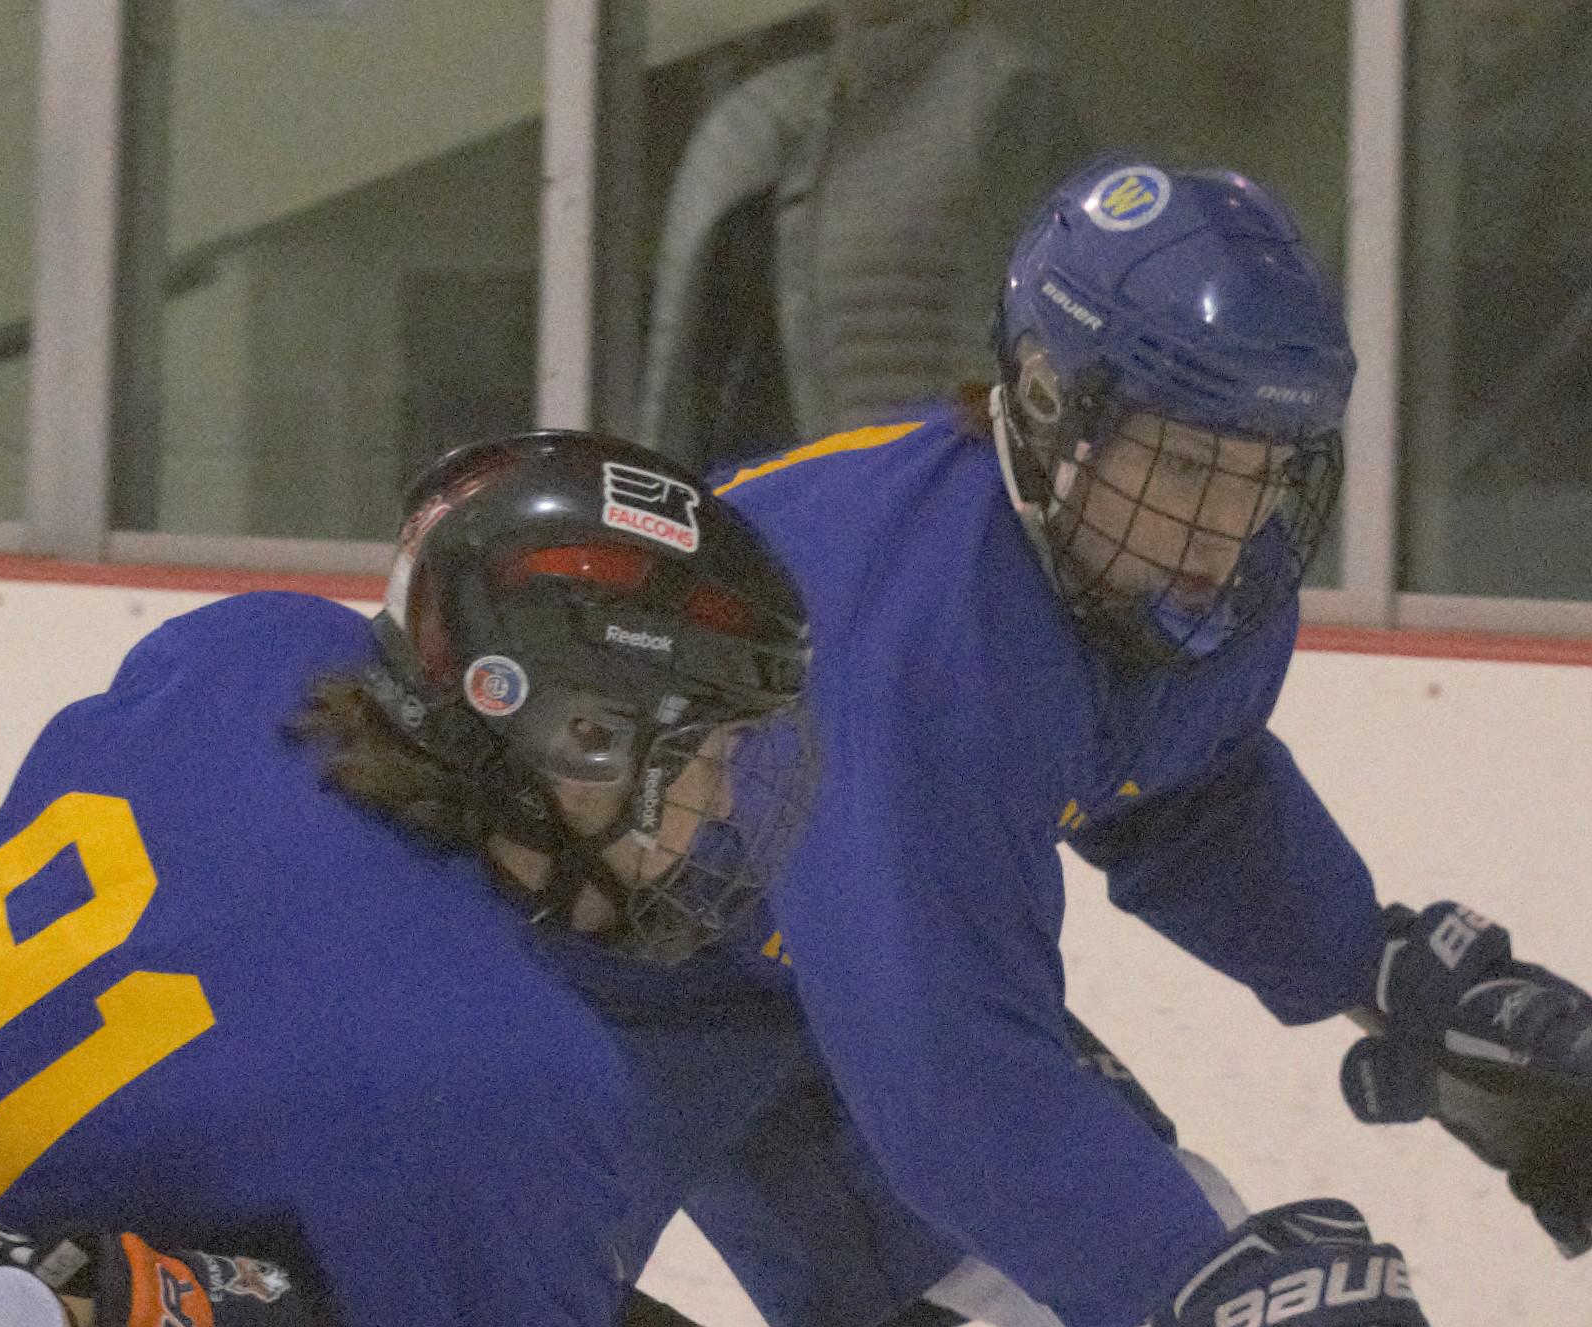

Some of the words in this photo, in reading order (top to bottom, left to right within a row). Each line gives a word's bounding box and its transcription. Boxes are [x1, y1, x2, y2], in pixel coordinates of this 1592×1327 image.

[1102, 175, 1156, 218] W
[1041, 281, 1103, 331] BAUER
[608, 505, 695, 549] FALCONS
[606, 624, 674, 653] Reebok
